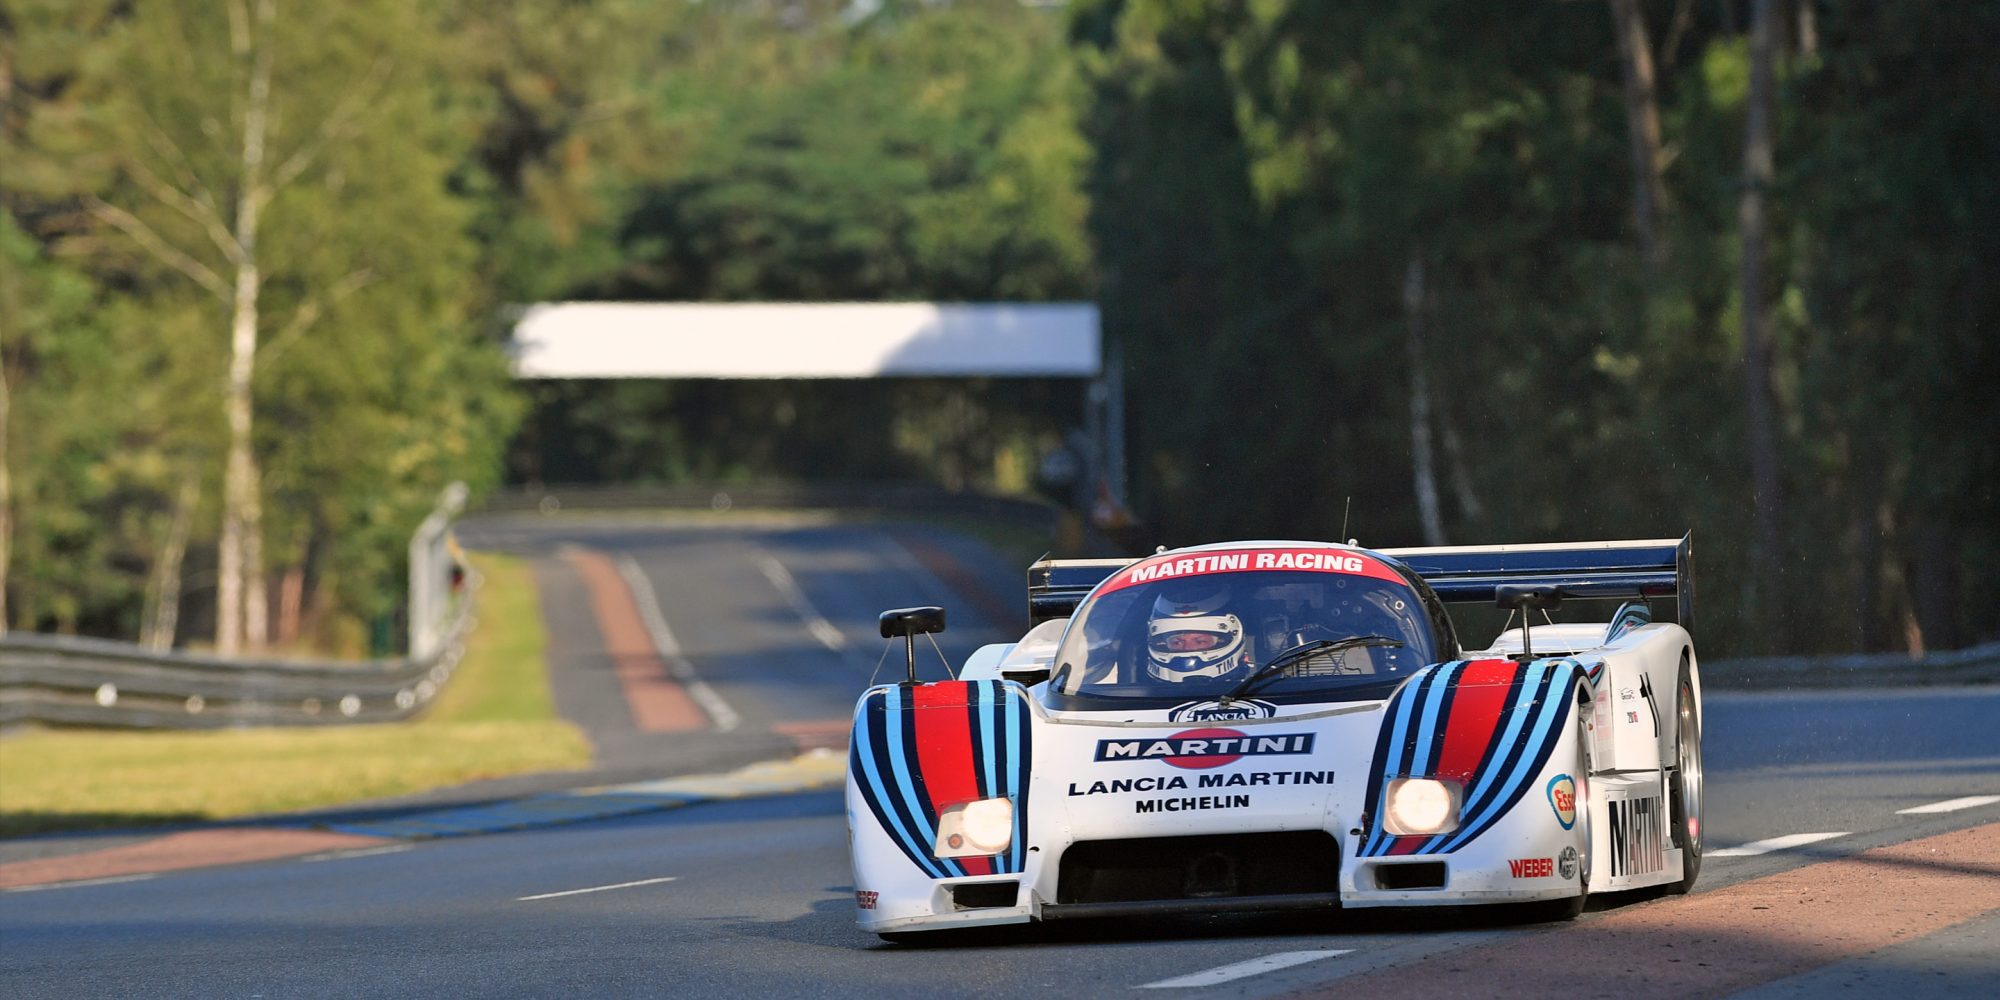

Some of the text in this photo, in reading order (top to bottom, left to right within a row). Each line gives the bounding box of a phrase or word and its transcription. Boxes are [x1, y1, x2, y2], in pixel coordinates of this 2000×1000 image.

[1131, 553, 1363, 583] MARTINI RACING
[1216, 657, 1235, 674] TIM
[1197, 712, 1246, 722] LANCIA
[1105, 736, 1306, 758] MARTINI
[1068, 771, 1335, 796] LANCIA MARTINI
[1135, 795, 1250, 813] MICHELIN
[1609, 796, 1663, 877] MARTINI
[1508, 858, 1553, 878] WEBER
